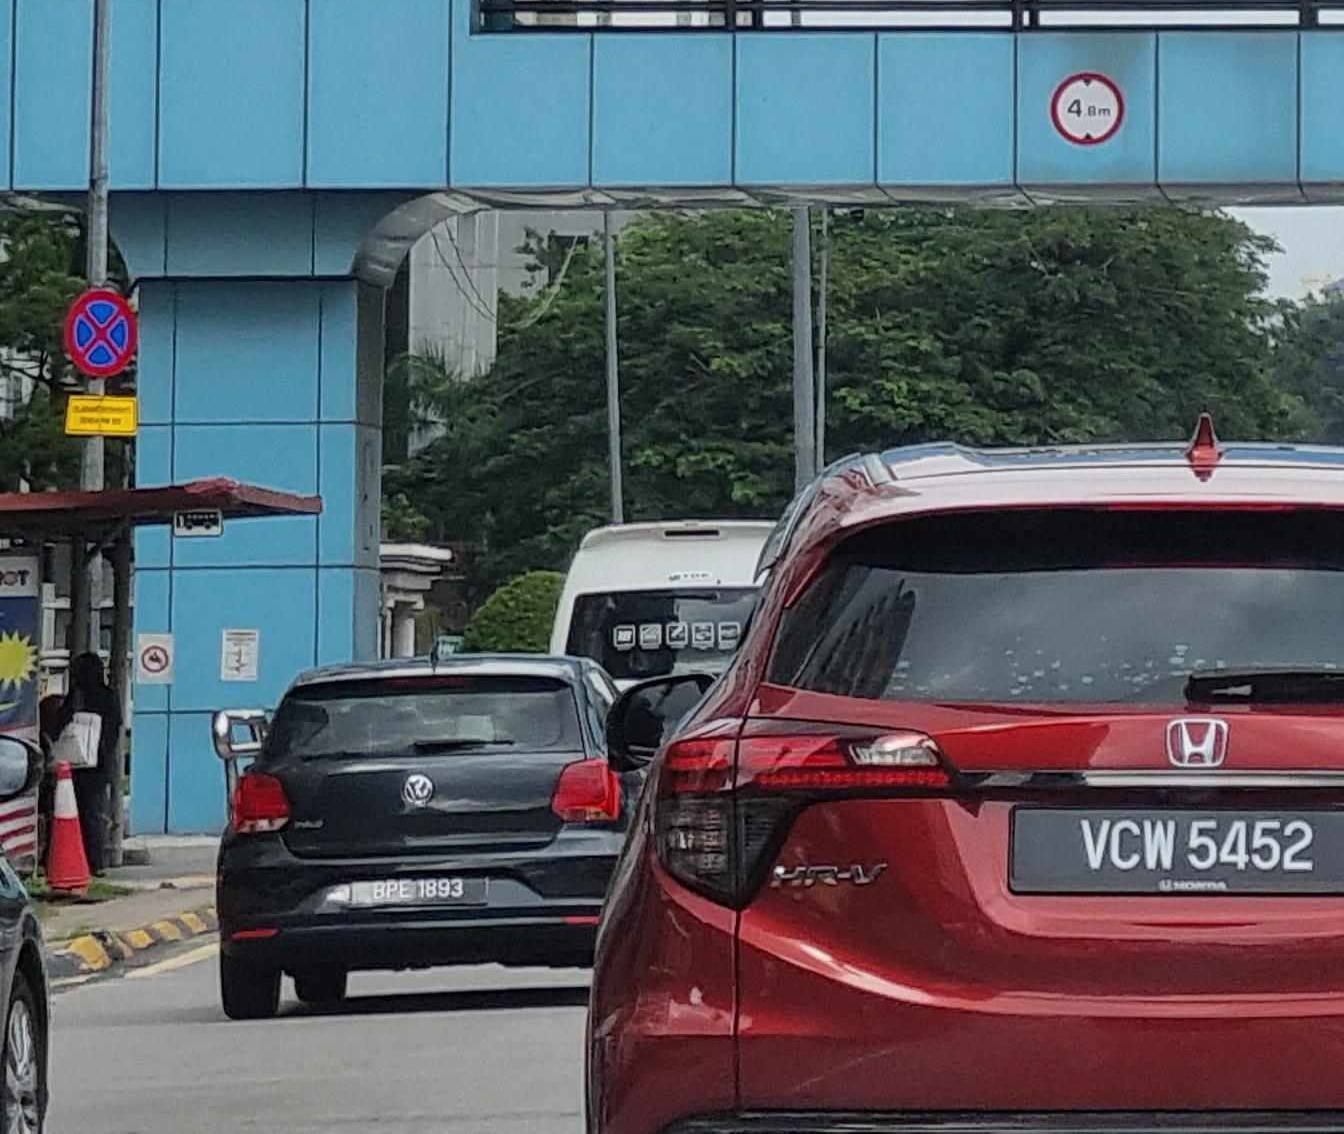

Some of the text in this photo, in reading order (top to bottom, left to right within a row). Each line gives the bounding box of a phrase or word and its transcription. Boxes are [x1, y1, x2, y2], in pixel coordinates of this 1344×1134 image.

[1080, 819, 1313, 871] VCW 5452
[373, 877, 464, 900] BPE 1893
